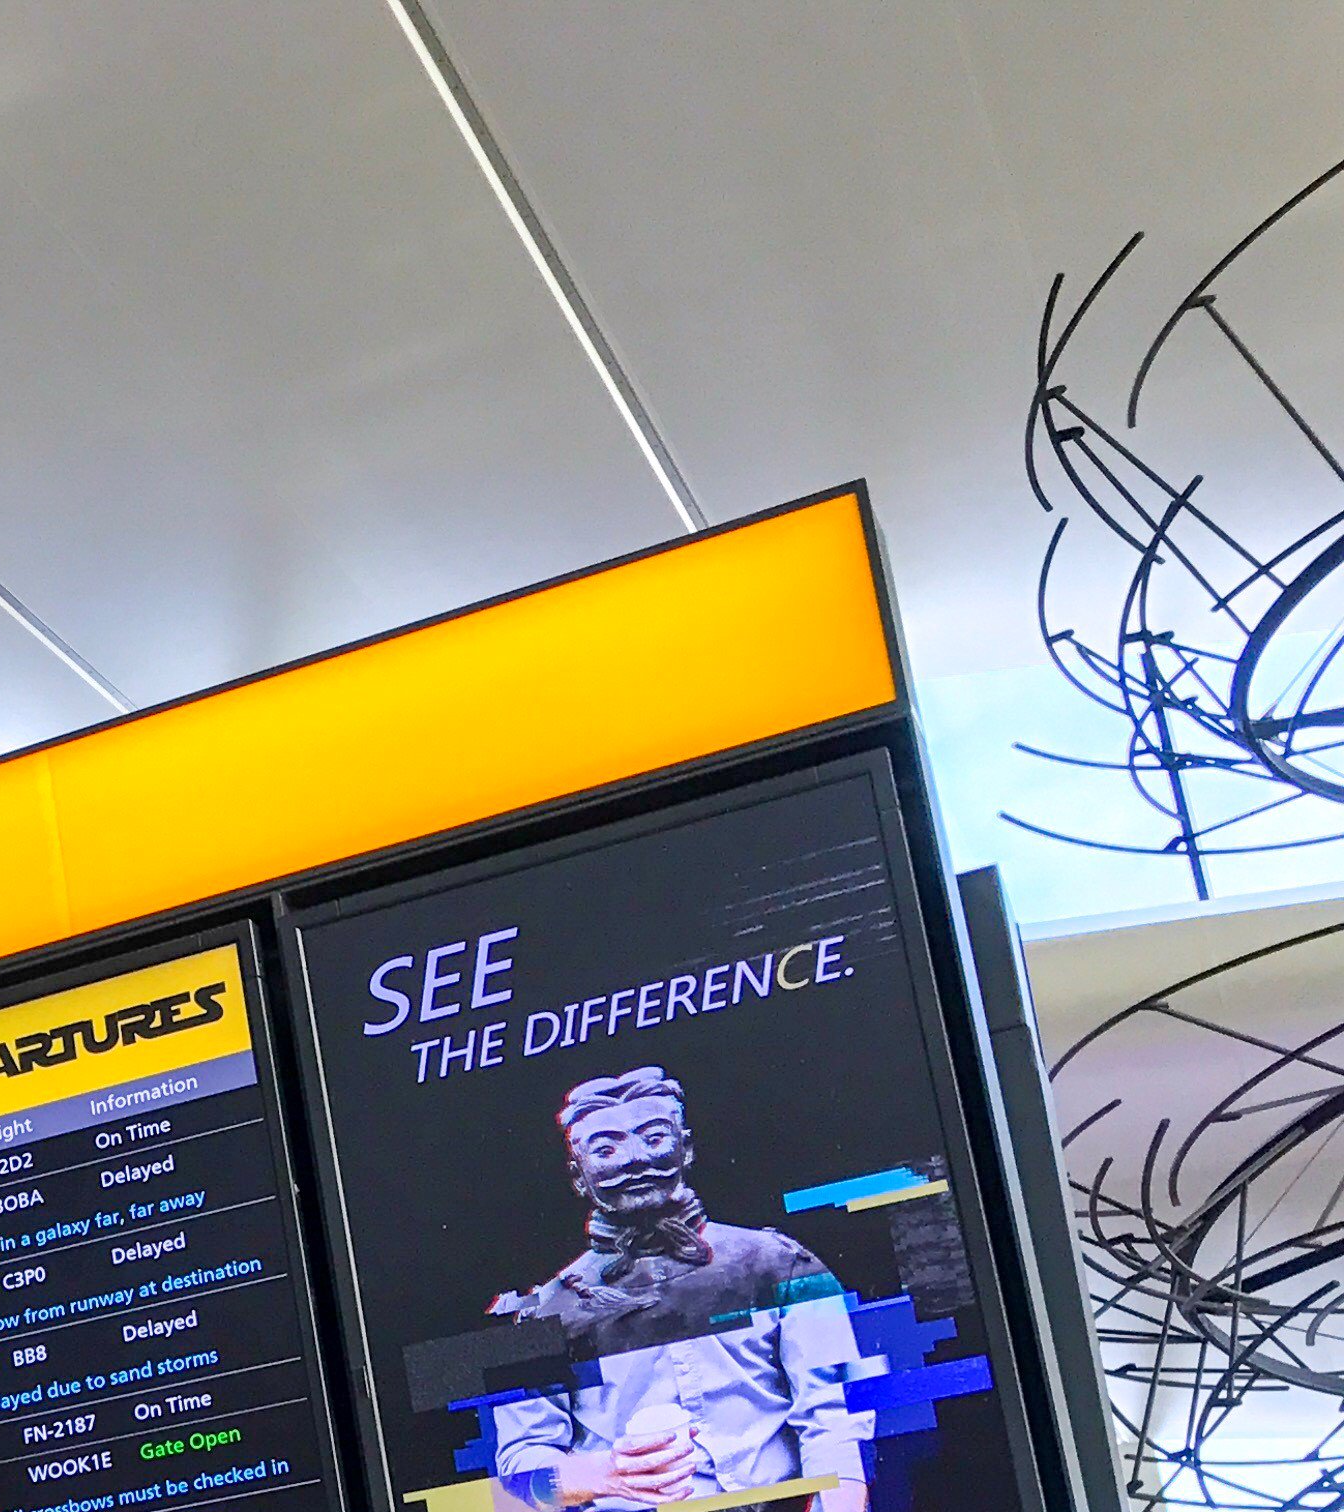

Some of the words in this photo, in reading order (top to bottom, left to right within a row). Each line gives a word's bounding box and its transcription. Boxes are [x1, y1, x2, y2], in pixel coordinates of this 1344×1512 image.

[362, 926, 520, 1038] SEE
[409, 1018, 504, 1084] THE
[523, 934, 856, 1059] DIFFERENCE.
[90, 1077, 198, 1115] Information
[95, 1132, 122, 1149] On
[125, 1120, 171, 1141] Time
[100, 1154, 174, 1187] Delayed
[0, 1236, 16, 1251] in
[20, 1234, 31, 1246] a
[35, 1218, 90, 1246] galaxy
[94, 1212, 124, 1228] far,
[128, 1203, 154, 1219] far
[159, 1190, 205, 1212] away
[111, 1231, 186, 1264] Delayed
[23, 1413, 95, 1444] FN-2187
[134, 1403, 162, 1420] On
[164, 1393, 212, 1413] Time
[140, 1440, 184, 1459] Gate
[189, 1428, 241, 1451] Open
